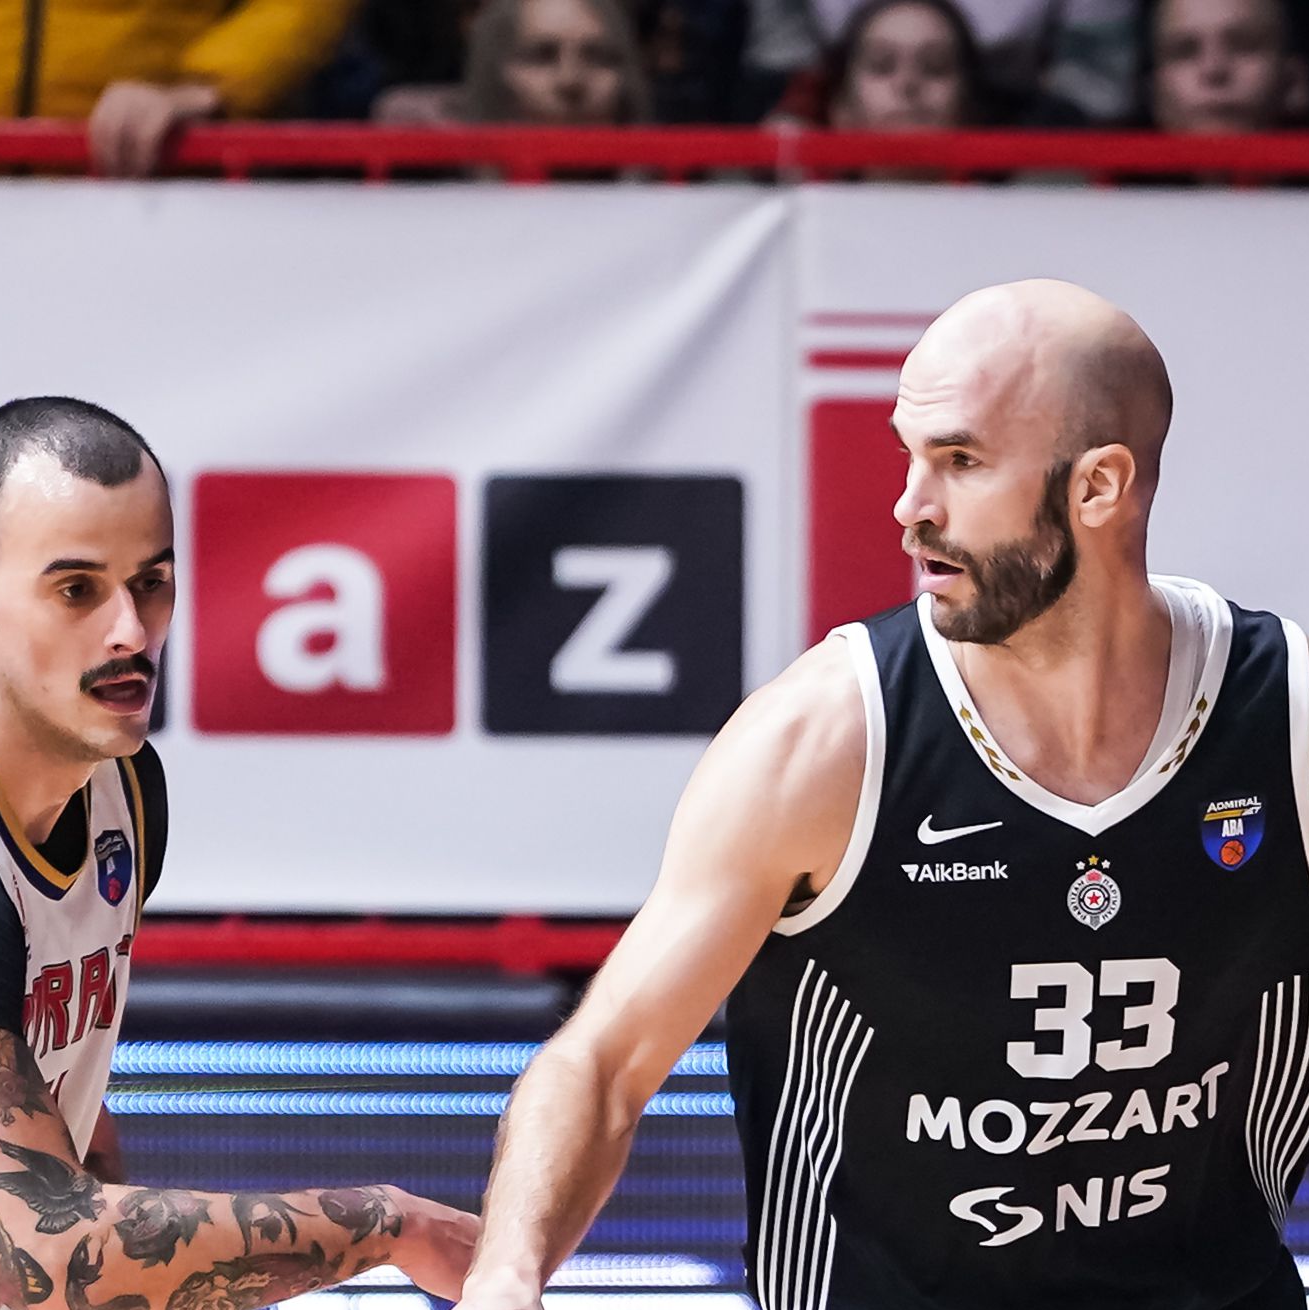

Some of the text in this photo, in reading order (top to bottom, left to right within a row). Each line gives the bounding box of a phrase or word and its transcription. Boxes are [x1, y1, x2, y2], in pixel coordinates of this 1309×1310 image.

[255, 541, 674, 693] az
[1207, 796, 1262, 813] ADMIRAL
[1221, 818, 1244, 837] ABA
[917, 860, 1009, 882] AikBank
[1006, 957, 1181, 1080] 33
[906, 1061, 1230, 1156] MOZZART
[1055, 1163, 1171, 1232] NIS
